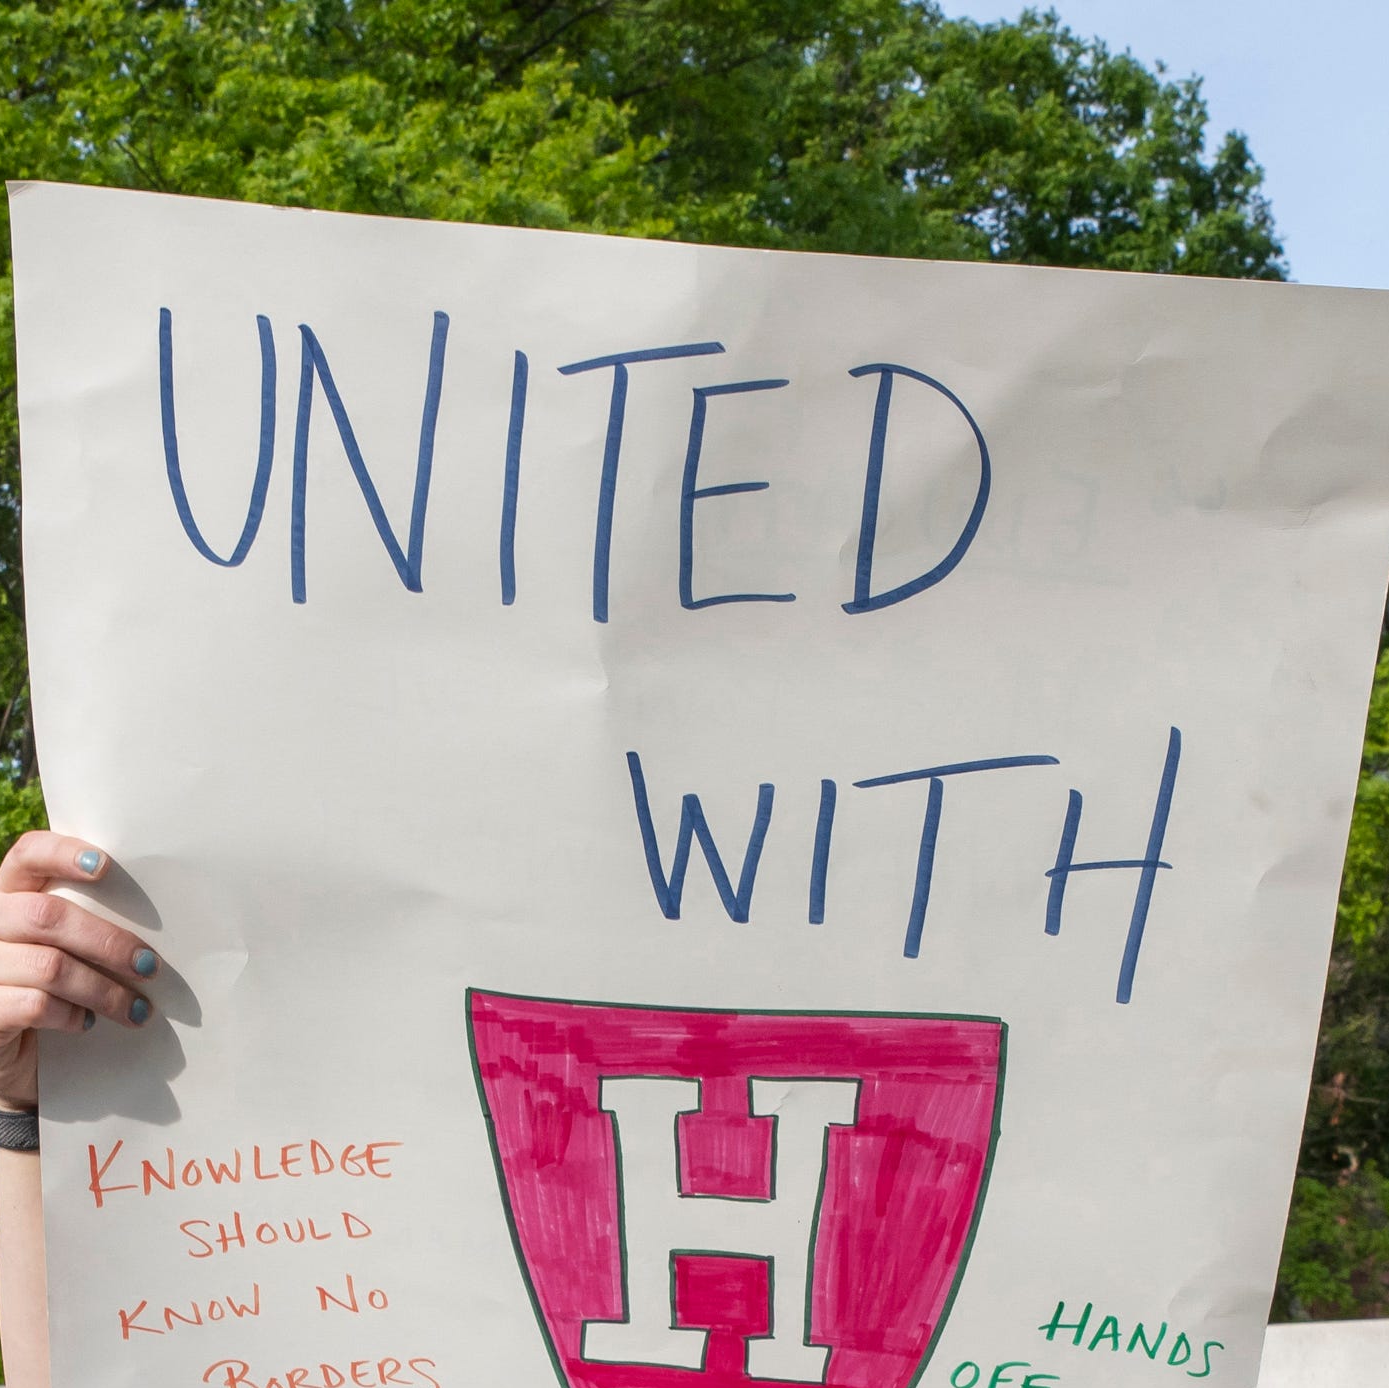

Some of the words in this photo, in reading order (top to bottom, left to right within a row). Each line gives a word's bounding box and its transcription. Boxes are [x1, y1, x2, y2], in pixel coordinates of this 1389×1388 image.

[159, 307, 992, 623] UNITED
[626, 727, 1182, 1003] WITH
[87, 1138, 402, 1209] KNOWLEDGE
[179, 1211, 373, 1259] SHOULD
[581, 1075, 862, 1385] H
[118, 1281, 260, 1341] KNOW
[315, 1273, 389, 1313] NO
[1038, 1300, 1224, 1378] HANDS
